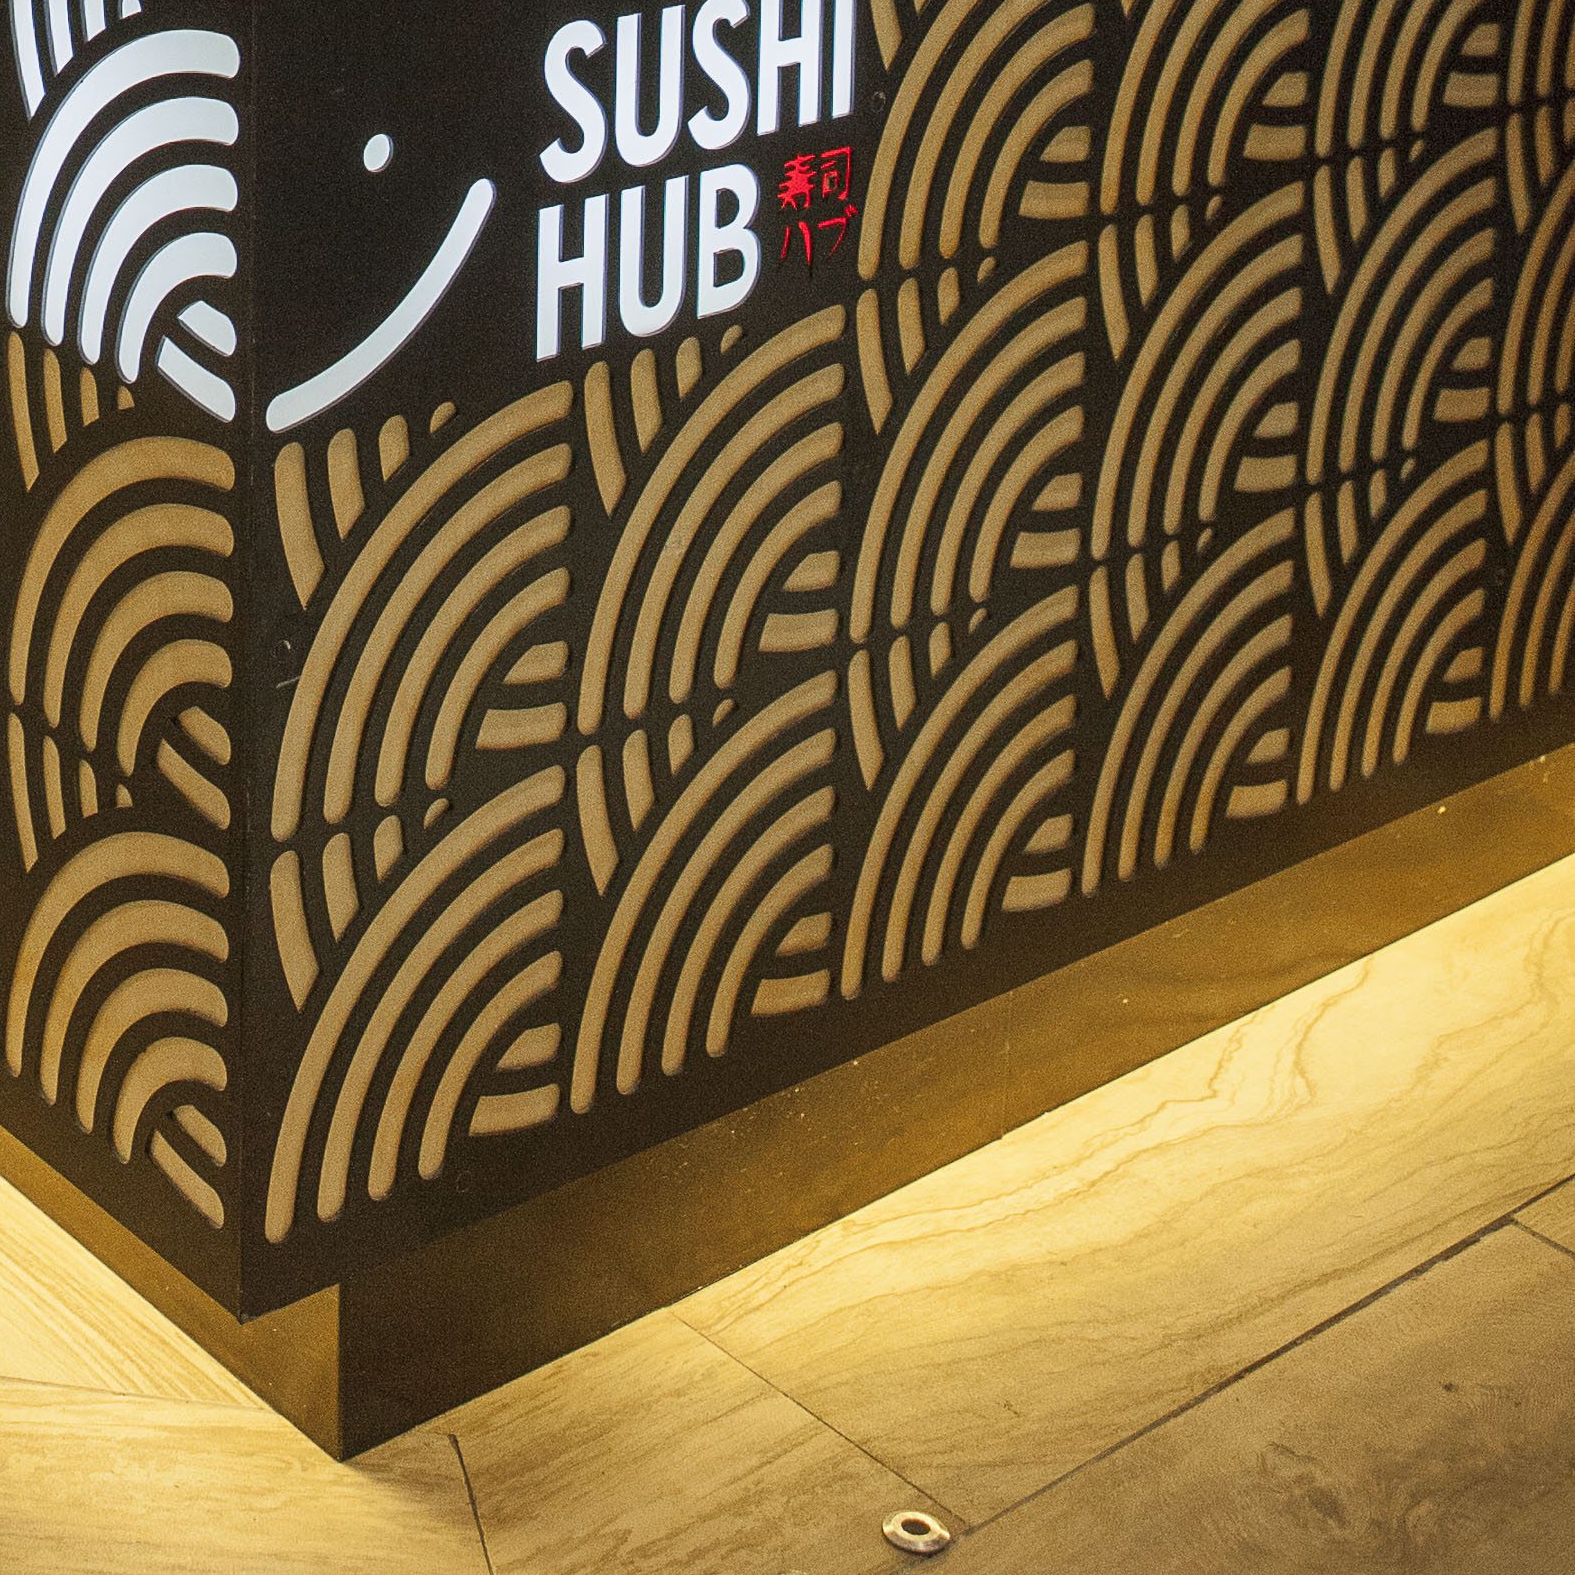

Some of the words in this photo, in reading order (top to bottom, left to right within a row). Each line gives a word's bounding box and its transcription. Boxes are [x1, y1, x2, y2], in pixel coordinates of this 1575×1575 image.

[777, 146, 852, 210] 寿司
[536, 163, 761, 362] HUB
[779, 204, 859, 267] ハブ
